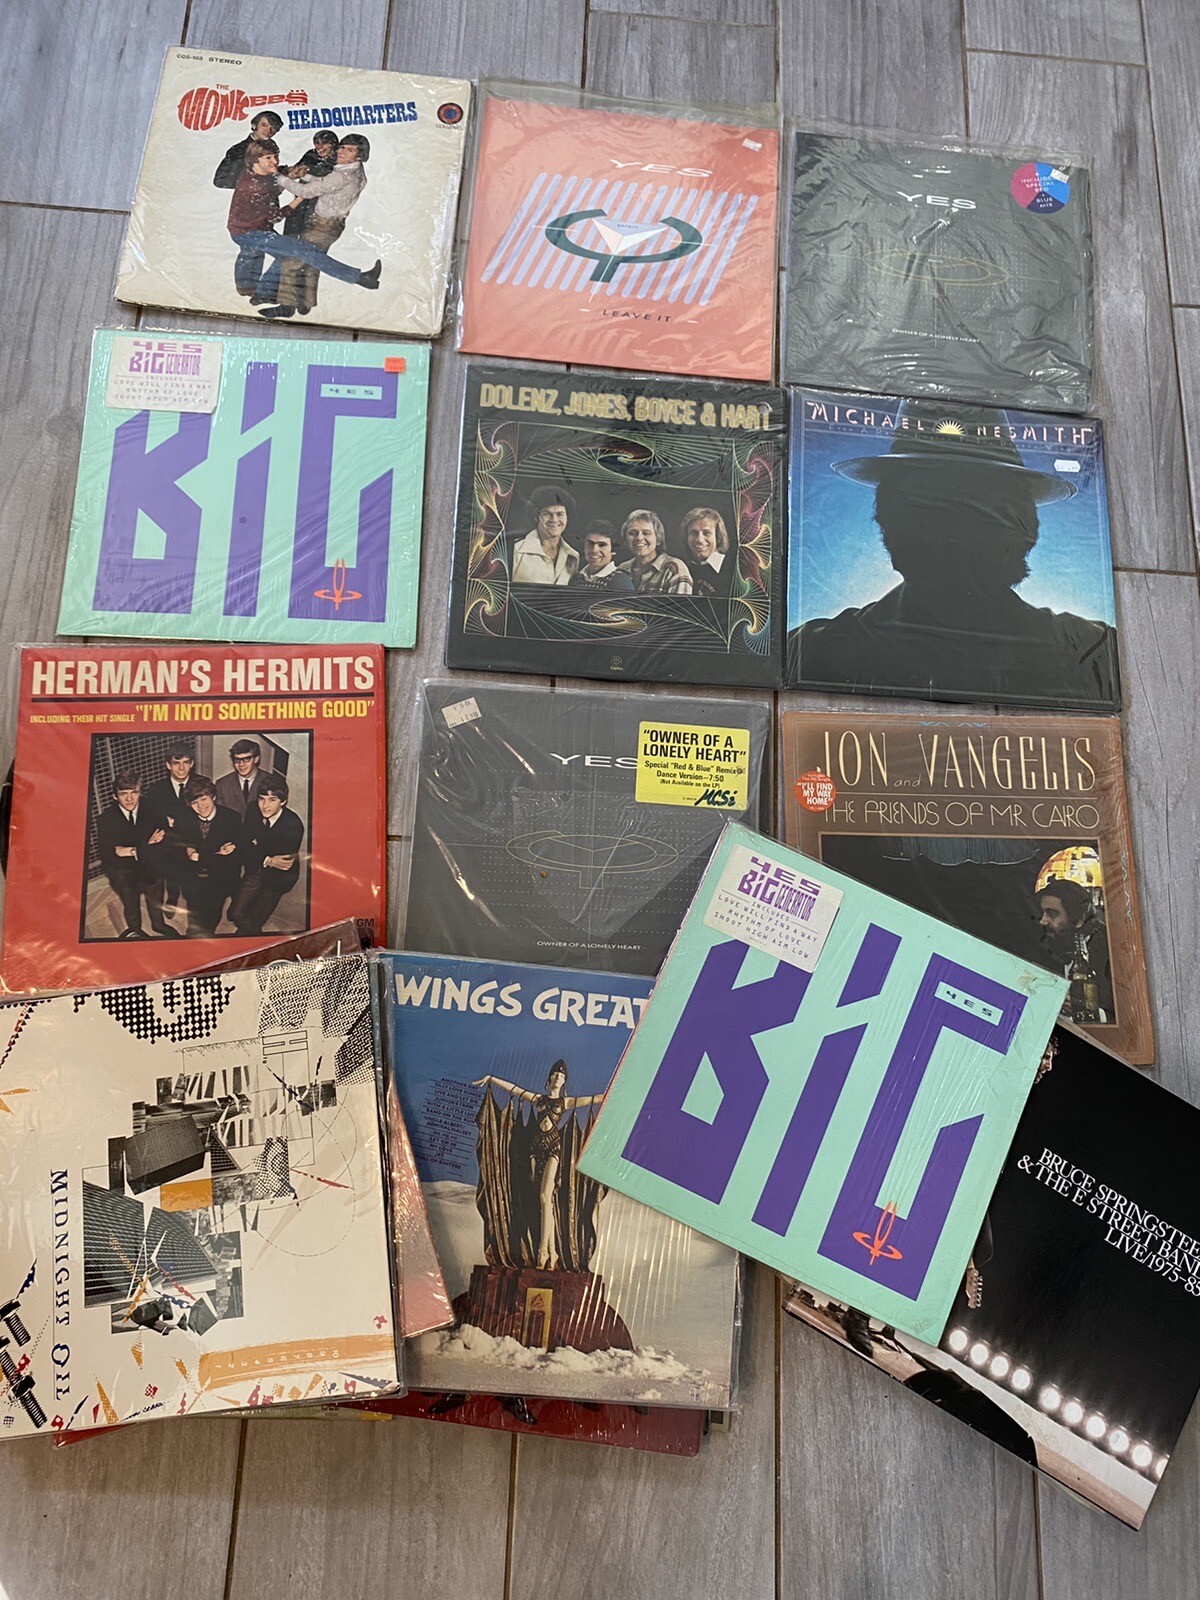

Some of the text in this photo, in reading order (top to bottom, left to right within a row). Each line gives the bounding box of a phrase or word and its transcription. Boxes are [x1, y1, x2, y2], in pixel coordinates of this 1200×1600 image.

[208, 57, 242, 65] STEREO
[287, 101, 418, 130] HEADQUARTERS
[609, 158, 713, 177] YES
[896, 190, 976, 210] YES
[602, 309, 651, 320] LEAVE
[133, 340, 202, 353] YES
[129, 351, 165, 374] BIG
[480, 383, 772, 430] DOLENZ, JONES, BOYCE & HART
[806, 402, 925, 431] MICHAEL
[977, 425, 1093, 446] NESMITH
[92, 362, 398, 623] BIG
[32, 656, 374, 695] HERMAN'S HERMITS
[30, 700, 374, 723] INCLUDING THEIR HIT SINGLE "I'M INTO SOMETHING GOOD"
[643, 729, 733, 748] "OWNER OF A
[550, 752, 637, 769] YES
[643, 743, 746, 763] LONELY HEART"
[817, 730, 1095, 791] JON and VANGELIS
[645, 761, 669, 769] Special
[671, 762, 687, 770] "Red
[696, 764, 714, 772] Blue"
[656, 770, 677, 778] Dance
[803, 789, 832, 798] MY WAY
[816, 782, 833, 790] FIND
[807, 797, 833, 805] HOME"
[864, 800, 940, 826] FRIENDS
[944, 801, 984, 827] OF
[990, 804, 1027, 827] MR
[1032, 803, 1100, 829] CAIRO
[737, 869, 780, 905] BIG
[750, 856, 821, 896] YES
[717, 894, 741, 908] LOVE
[743, 906, 765, 919] WILL
[768, 917, 790, 931] FIND
[800, 932, 817, 943] WAY
[751, 902, 790, 922] INCLUDES
[714, 912, 742, 928] SHOOT
[745, 927, 768, 940] HIGH
[772, 938, 789, 949] AIM
[792, 947, 809, 958] LOW
[728, 909, 762, 927] RHYTHM
[764, 925, 775, 934] OF
[778, 932, 801, 946] LOVE
[395, 973, 522, 1017] WINGS
[946, 990, 993, 1017] YES
[464, 1090, 482, 1098] SONGS
[426, 1108, 441, 1116] BAND
[427, 1101, 441, 1109] WITH
[446, 1106, 464, 1114] LITTLE
[620, 922, 1029, 1301] BIG
[424, 1115, 466, 1129] UNCLE ALBERT/
[426, 1121, 471, 1136] ADMIRAL HALSEY
[1038, 1147, 1096, 1193] BRUCE
[1017, 1155, 1034, 1174] &
[1035, 1162, 1072, 1197] THE
[1071, 1187, 1087, 1206] E
[1086, 1197, 1158, 1248] STREET
[50, 1168, 70, 1401] MIDNIGHT OIL
